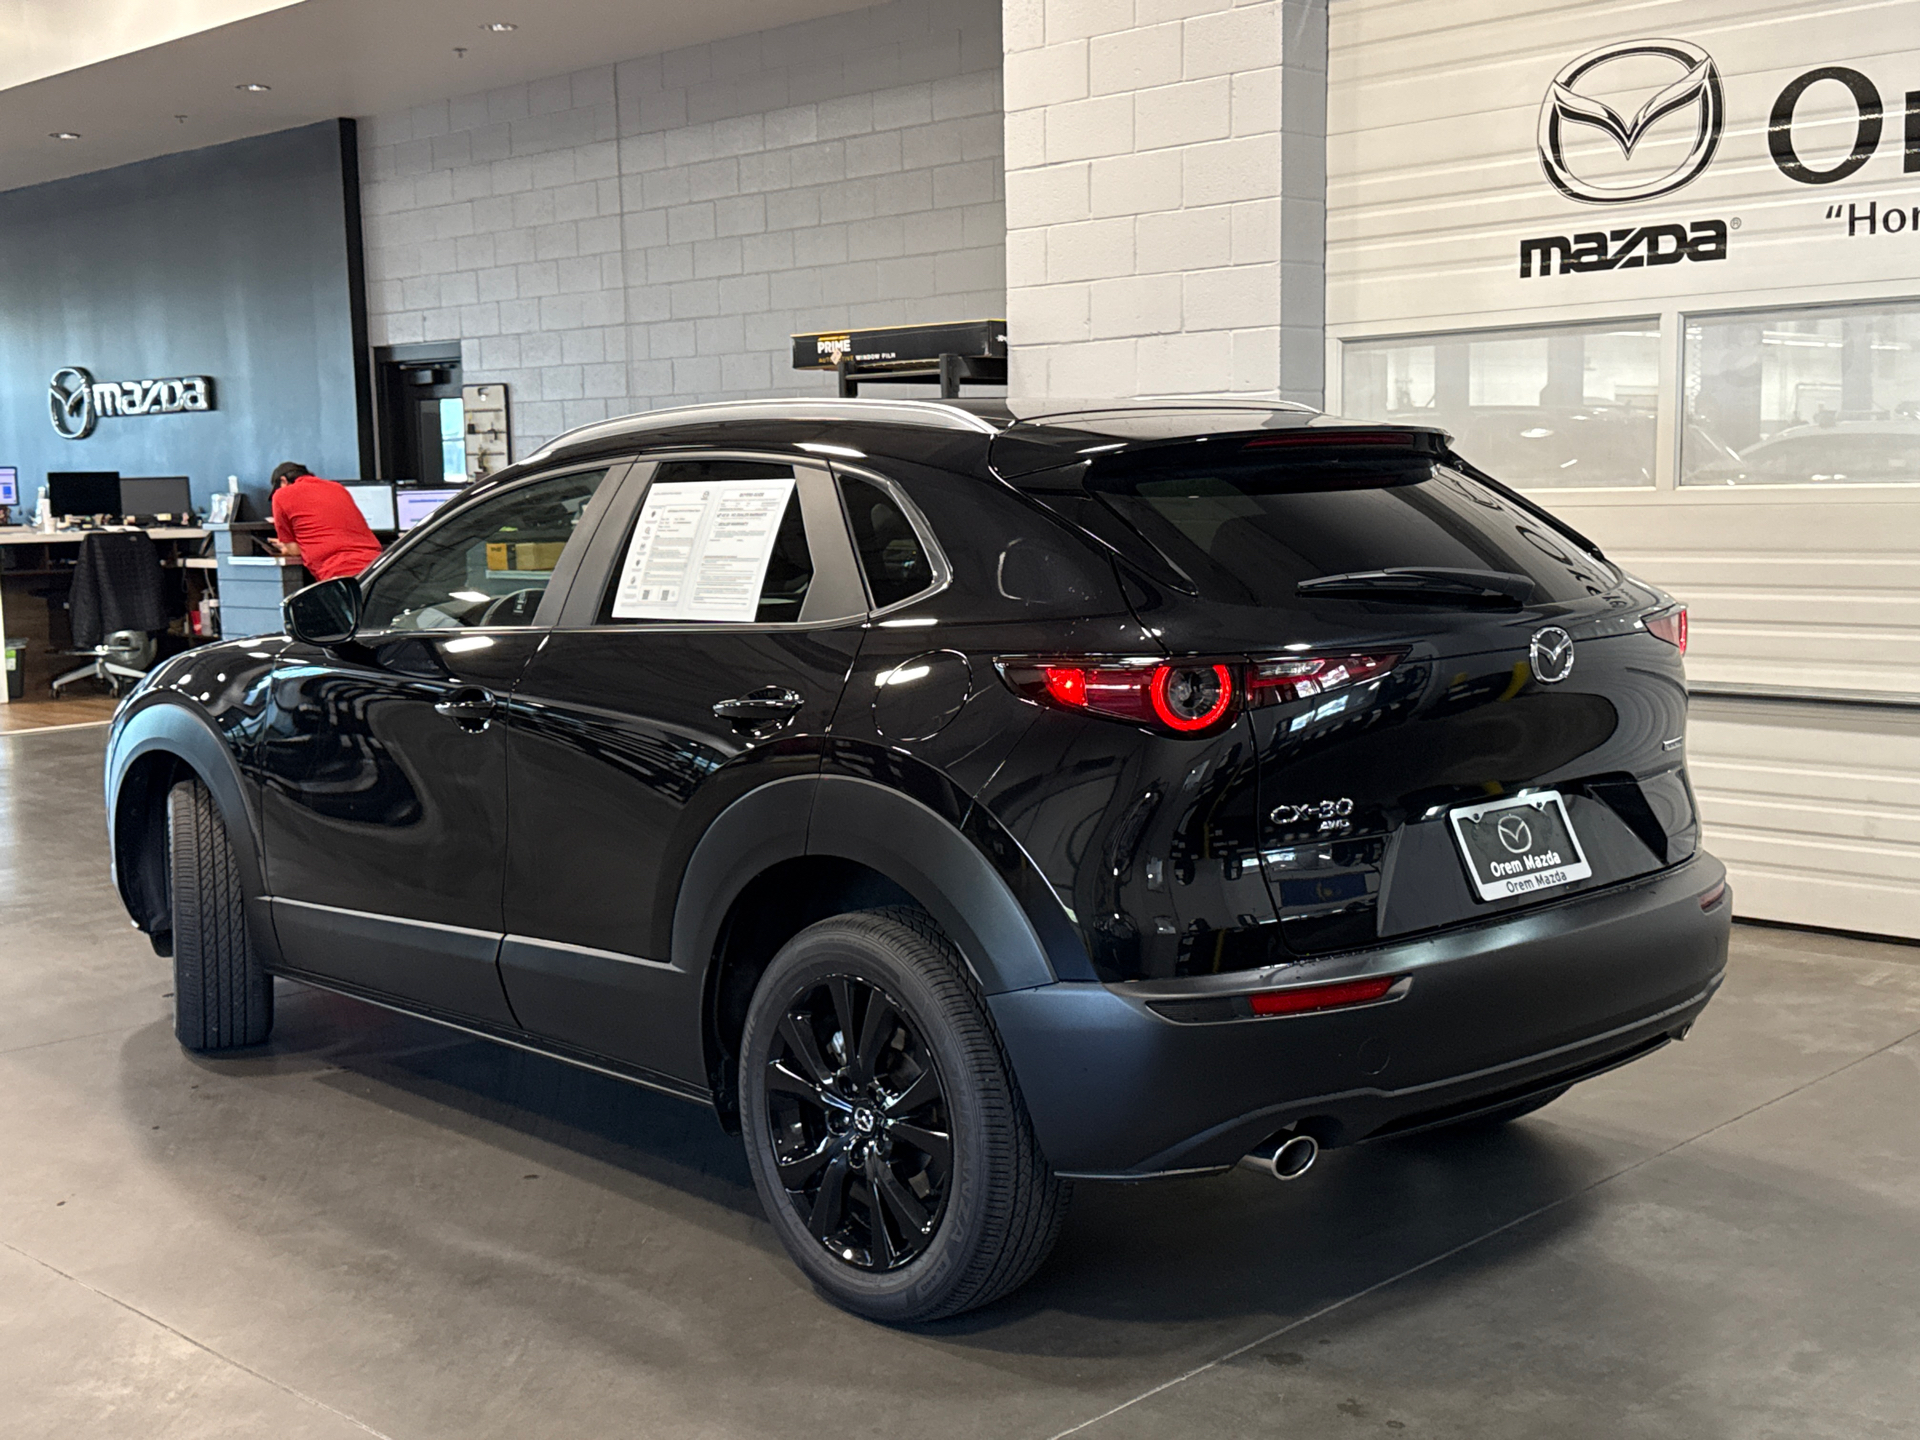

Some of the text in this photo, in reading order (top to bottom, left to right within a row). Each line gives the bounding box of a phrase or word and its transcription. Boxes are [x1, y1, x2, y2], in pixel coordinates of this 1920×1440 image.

[1767, 66, 1920, 184] O
[1825, 201, 1920, 236] “Ho
[1520, 219, 1727, 278] mazda
[817, 339, 851, 354] PRIME
[92, 375, 210, 417] mazda
[1270, 797, 1354, 824] CX-30
[1490, 850, 1561, 877] Orem Mazda
[1506, 870, 1567, 893] Orem Mazda
